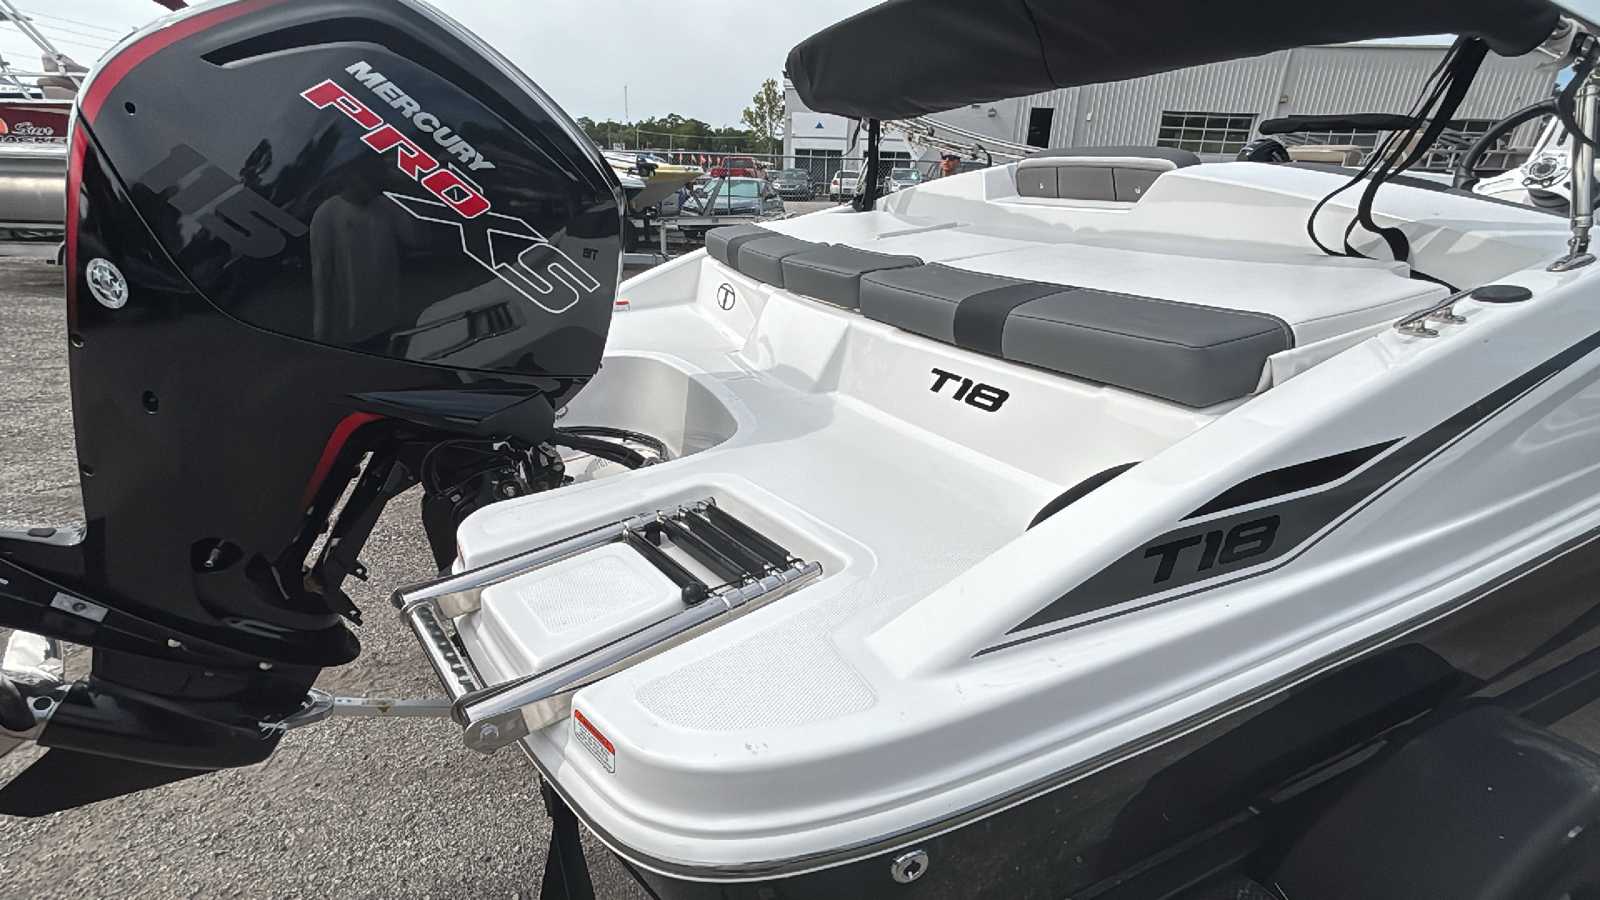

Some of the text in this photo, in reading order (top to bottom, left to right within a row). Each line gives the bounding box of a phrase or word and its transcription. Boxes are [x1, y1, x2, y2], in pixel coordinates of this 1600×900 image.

[300, 78, 492, 219] PRO
[345, 60, 496, 171] MERCURY
[382, 162, 601, 314] XS
[929, 367, 1010, 413] T18
[1143, 514, 1281, 584] T18
